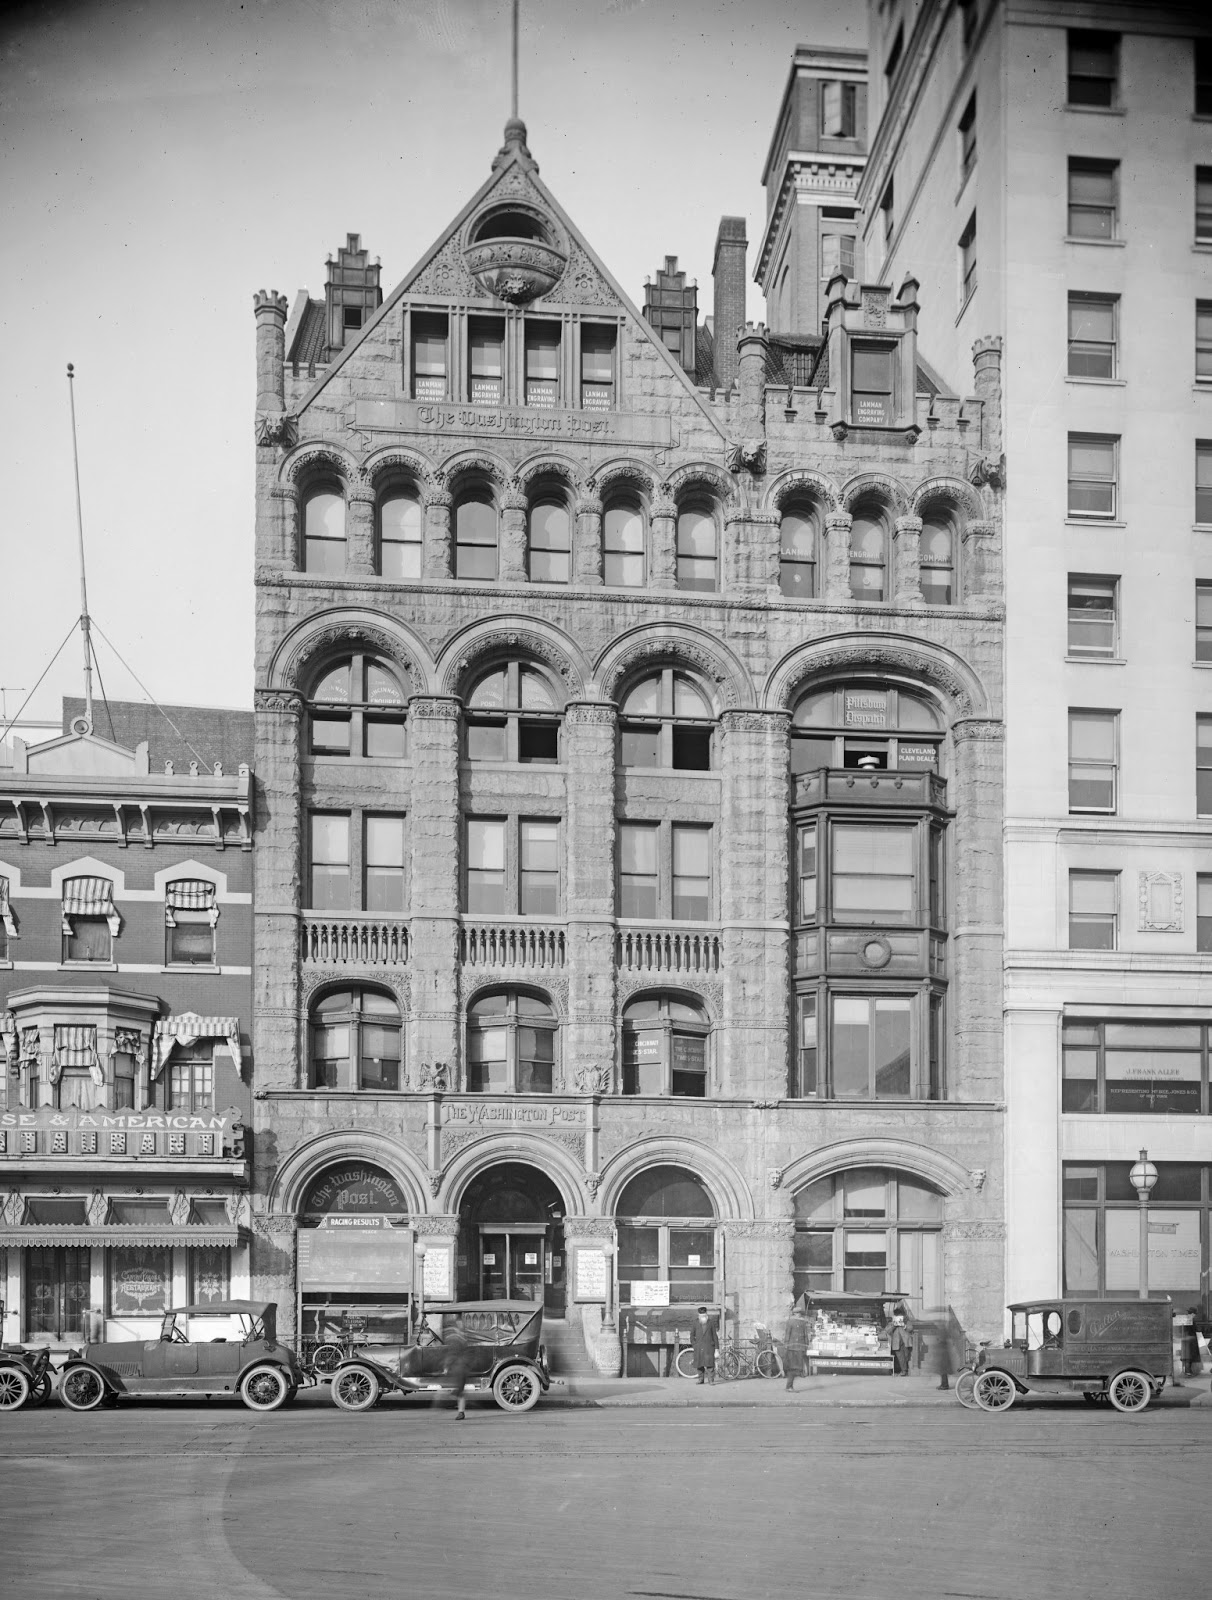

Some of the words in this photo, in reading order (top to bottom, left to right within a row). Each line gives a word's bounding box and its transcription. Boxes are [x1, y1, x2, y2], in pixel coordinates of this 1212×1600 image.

[528, 395, 556, 403] ENGRAVING
[583, 398, 610, 406] ENGRAVING
[418, 406, 455, 429] The
[459, 411, 562, 434] Washington
[920, 554, 948, 562] COMPAN
[442, 1104, 467, 1124] THE
[465, 1104, 548, 1124] WASHINGTON
[49, 1114, 70, 1126] &
[79, 1115, 228, 1129] AMERICAN
[312, 1184, 332, 1207] The
[329, 1170, 399, 1207] Washington
[331, 1218, 352, 1226] RACING
